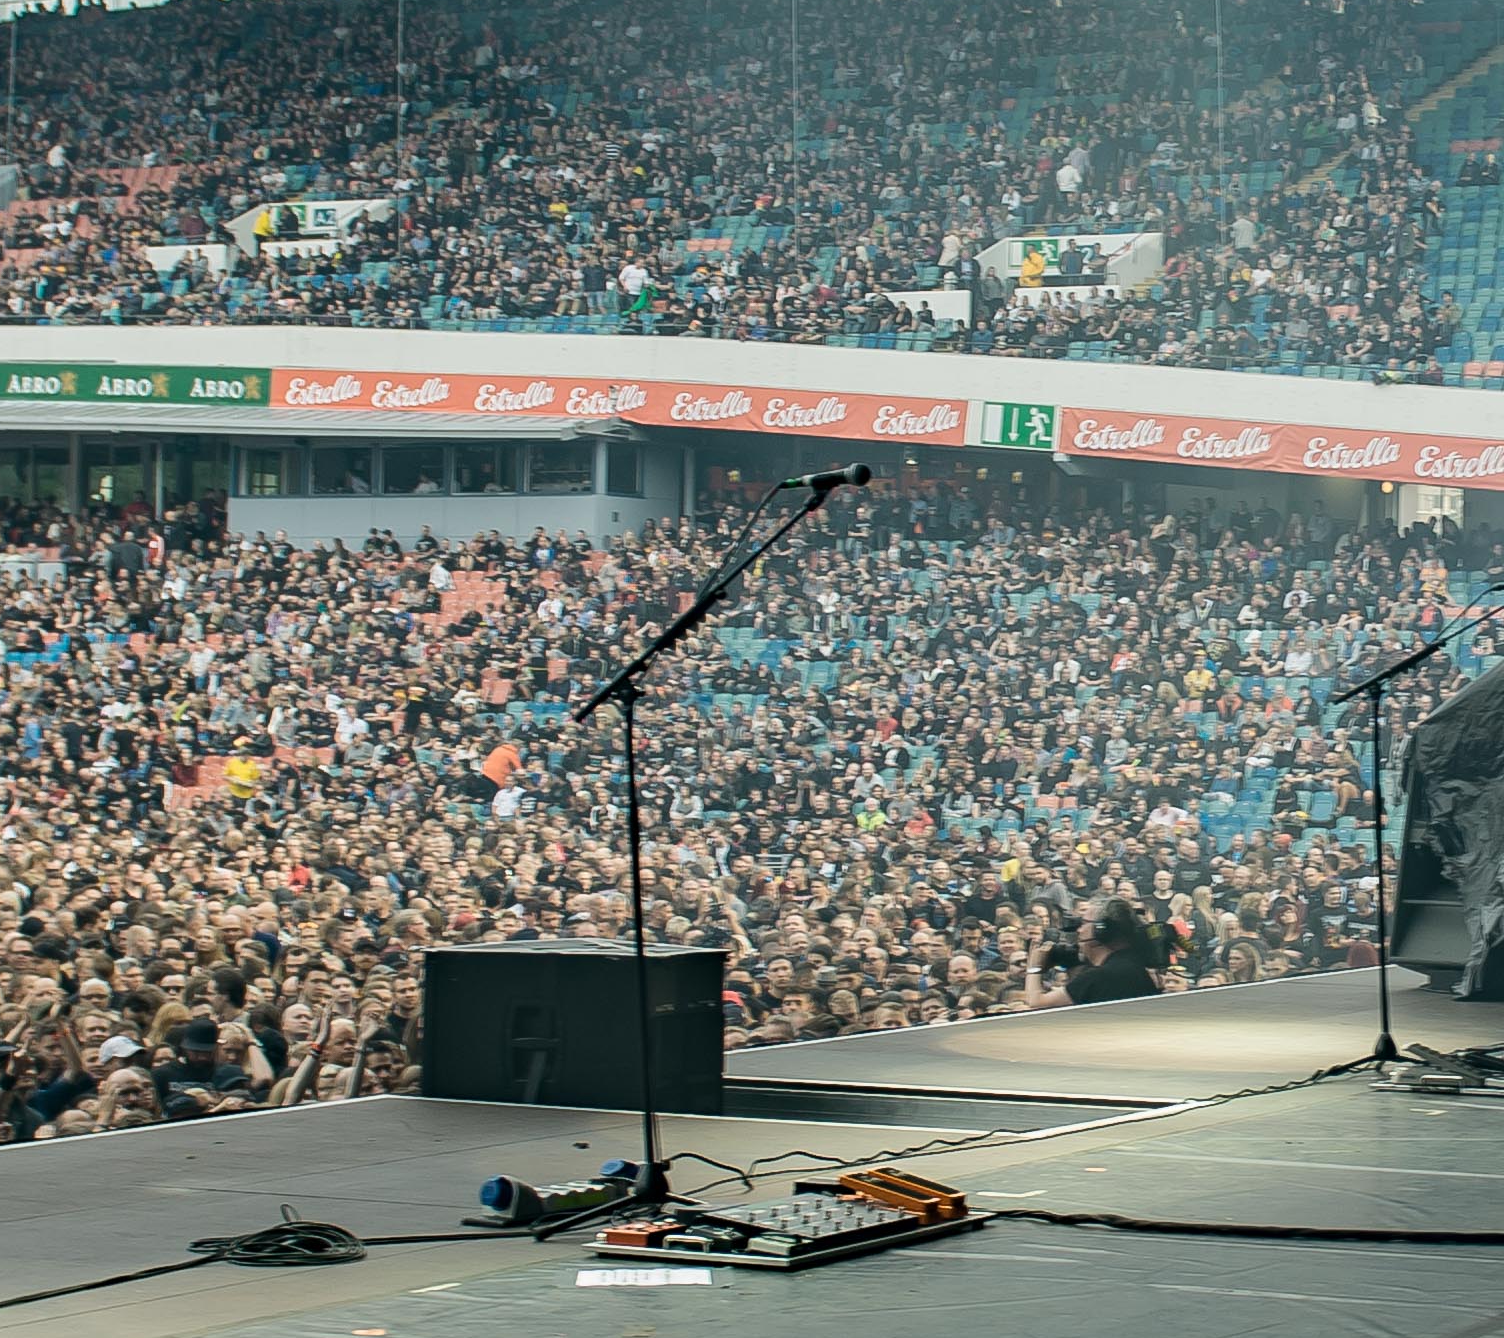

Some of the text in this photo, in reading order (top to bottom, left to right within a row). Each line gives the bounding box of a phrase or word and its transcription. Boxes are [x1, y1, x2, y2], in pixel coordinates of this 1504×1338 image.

[285, 375, 362, 405] Estrella
[371, 377, 451, 408] Estrella
[474, 380, 556, 412] Estrella
[566, 385, 647, 414] Estrlla
[670, 390, 753, 421] Estrella
[762, 396, 847, 427] Estrella
[872, 404, 961, 436] Estrella
[1073, 419, 1167, 450] Estrella
[1176, 427, 1272, 459] Estrella
[1303, 436, 1401, 469] Estrella
